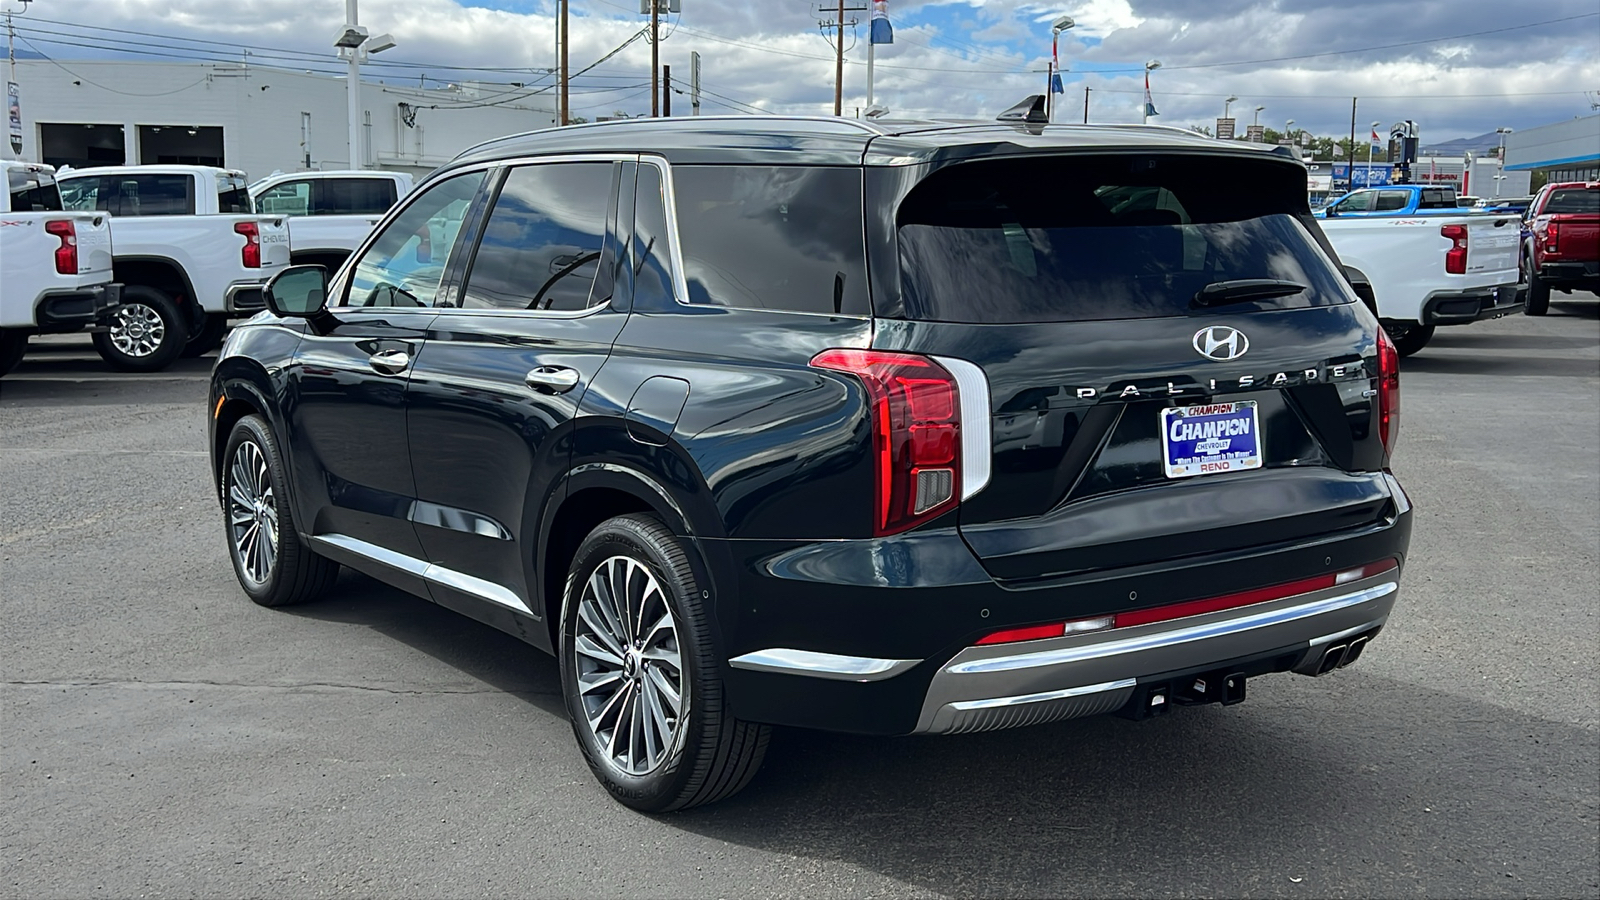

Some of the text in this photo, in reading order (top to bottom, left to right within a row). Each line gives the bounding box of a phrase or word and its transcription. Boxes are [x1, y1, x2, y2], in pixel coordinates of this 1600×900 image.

[1076, 366, 1347, 398] PALISADE
[1188, 403, 1233, 416] CHAMPION
[1197, 441, 1229, 450] CHEVROLET
[1200, 461, 1230, 473] RENO
